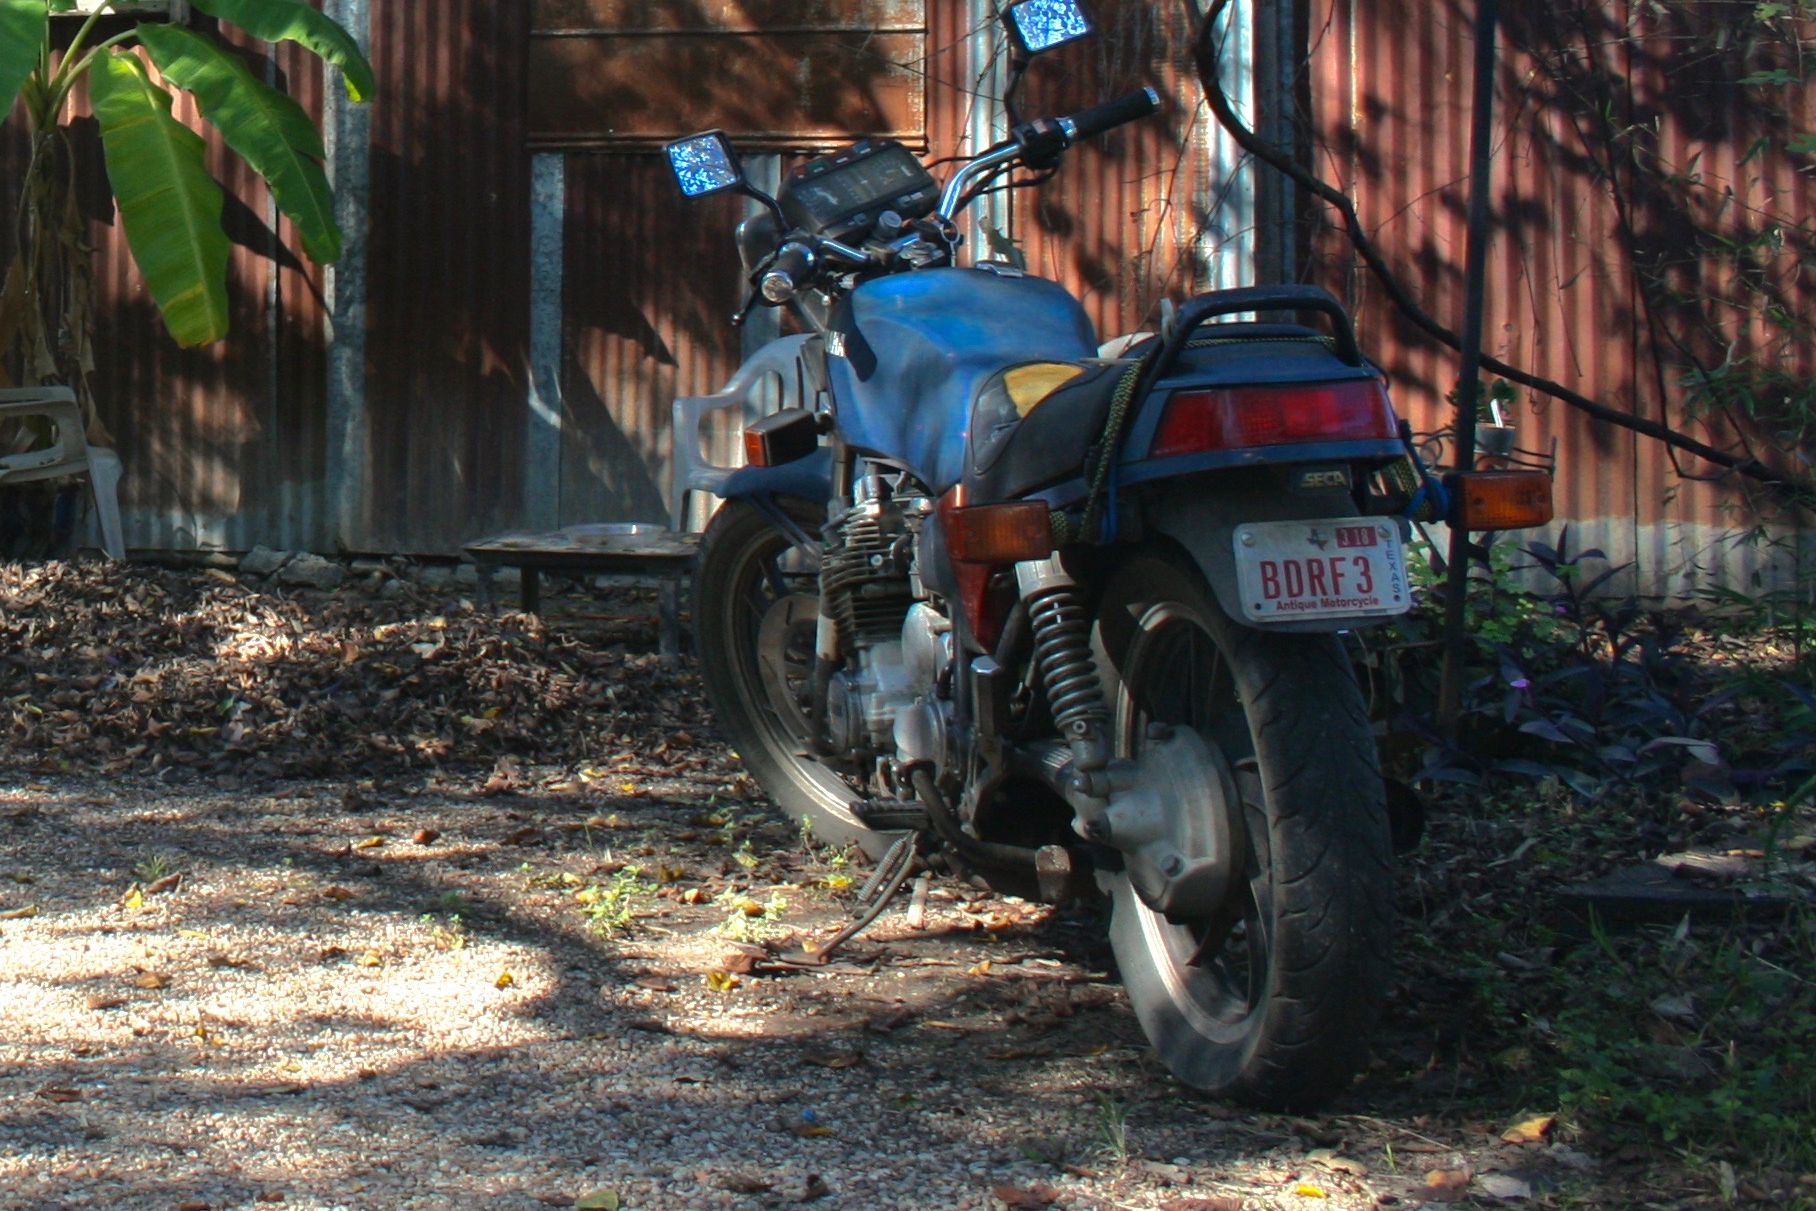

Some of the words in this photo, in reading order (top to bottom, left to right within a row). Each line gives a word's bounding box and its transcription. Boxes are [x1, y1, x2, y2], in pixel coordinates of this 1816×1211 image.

[1385, 539, 1401, 593] TEXAS
[1276, 599, 1317, 611] Antique
[1320, 596, 1379, 608] Motorcycle
